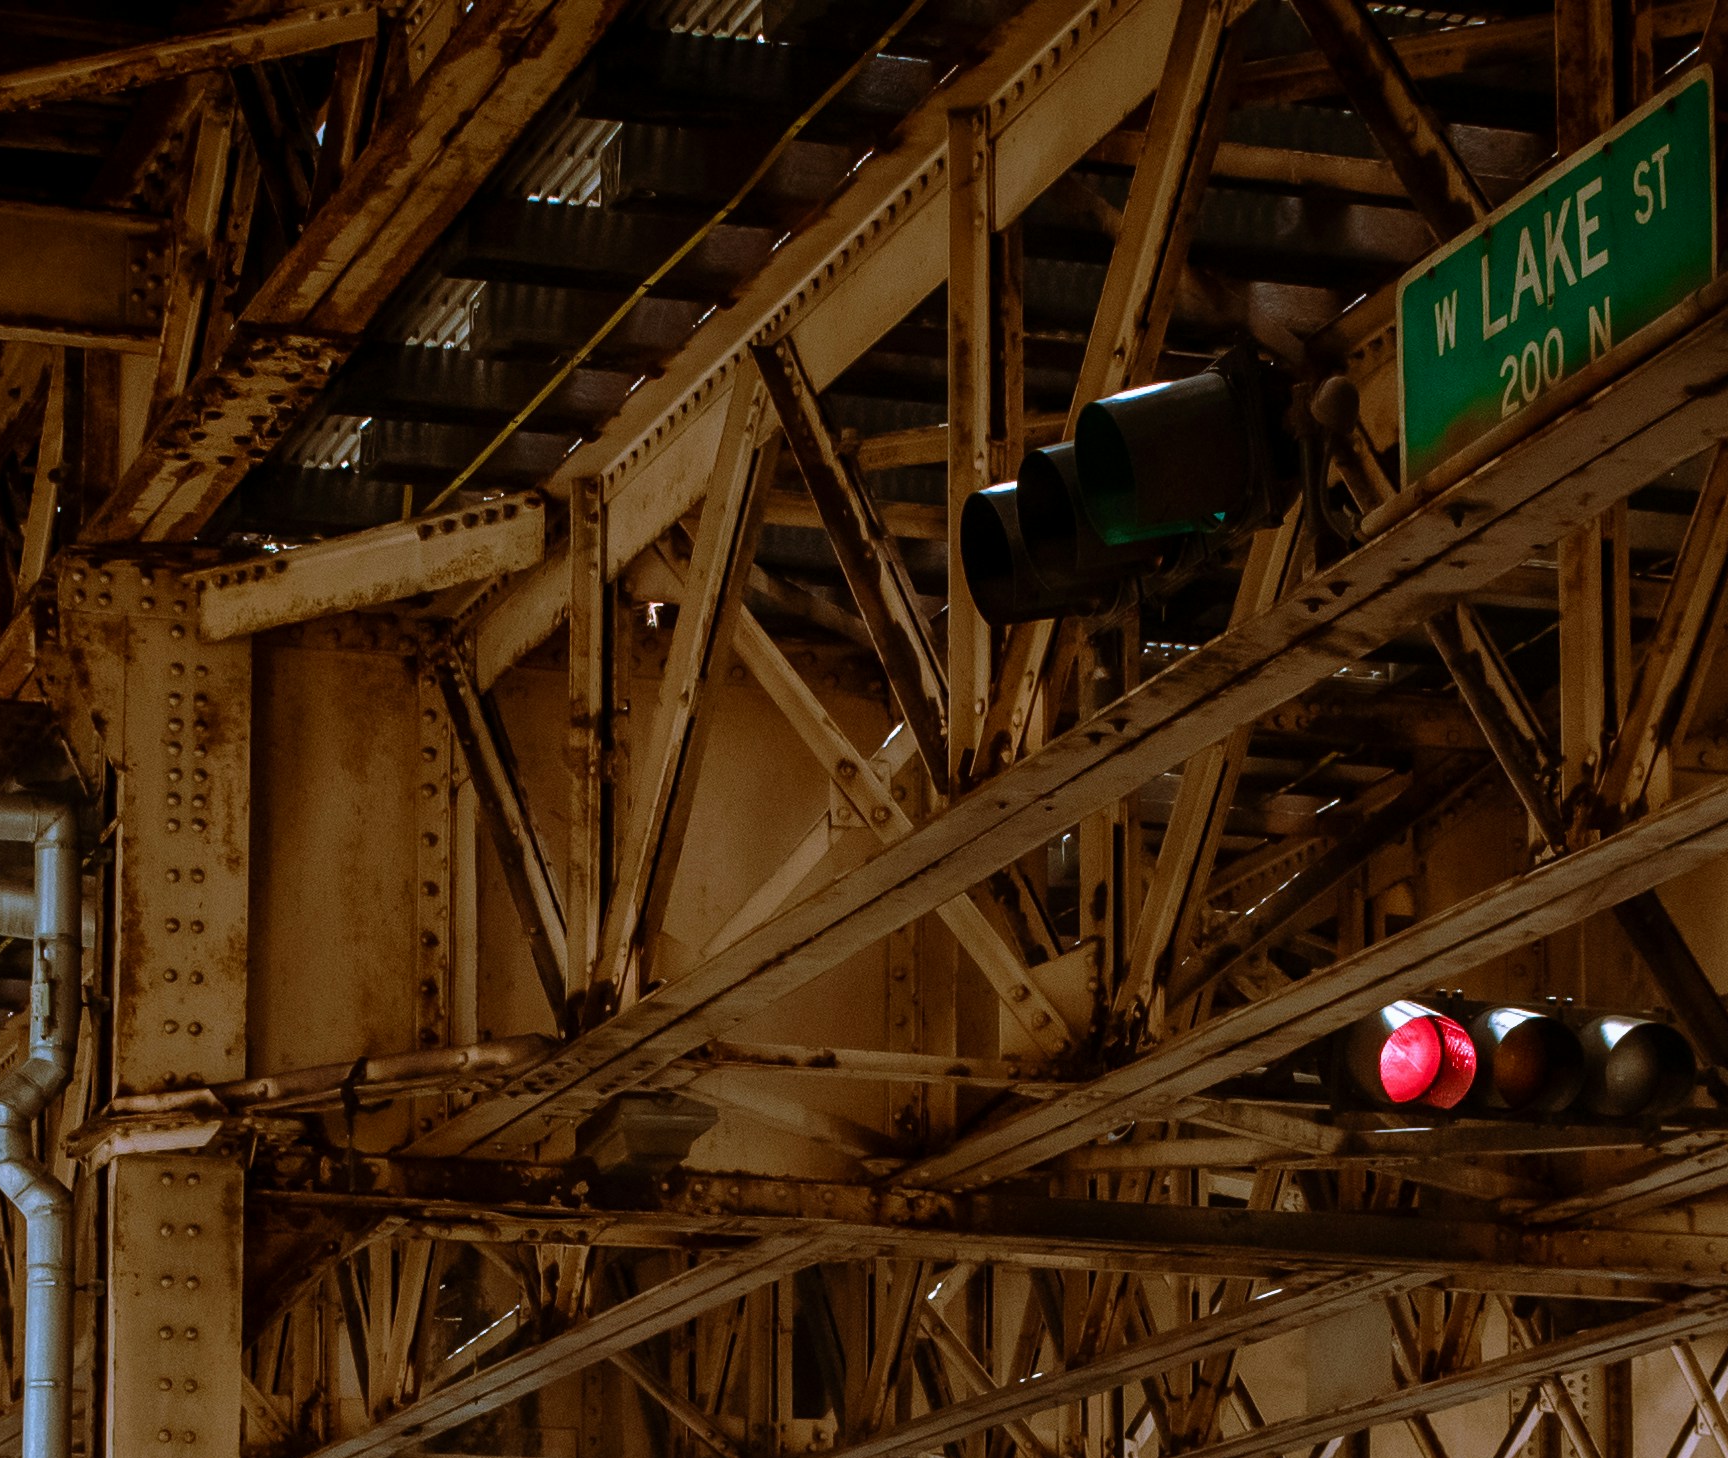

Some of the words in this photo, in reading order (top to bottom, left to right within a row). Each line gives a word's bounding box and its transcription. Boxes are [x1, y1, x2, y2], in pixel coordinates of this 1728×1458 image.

[1435, 289, 1458, 356] W
[1481, 176, 1610, 342] LAKE
[1632, 144, 1671, 225] ST
[1499, 328, 1564, 420] 200
[1588, 296, 1612, 364] N
